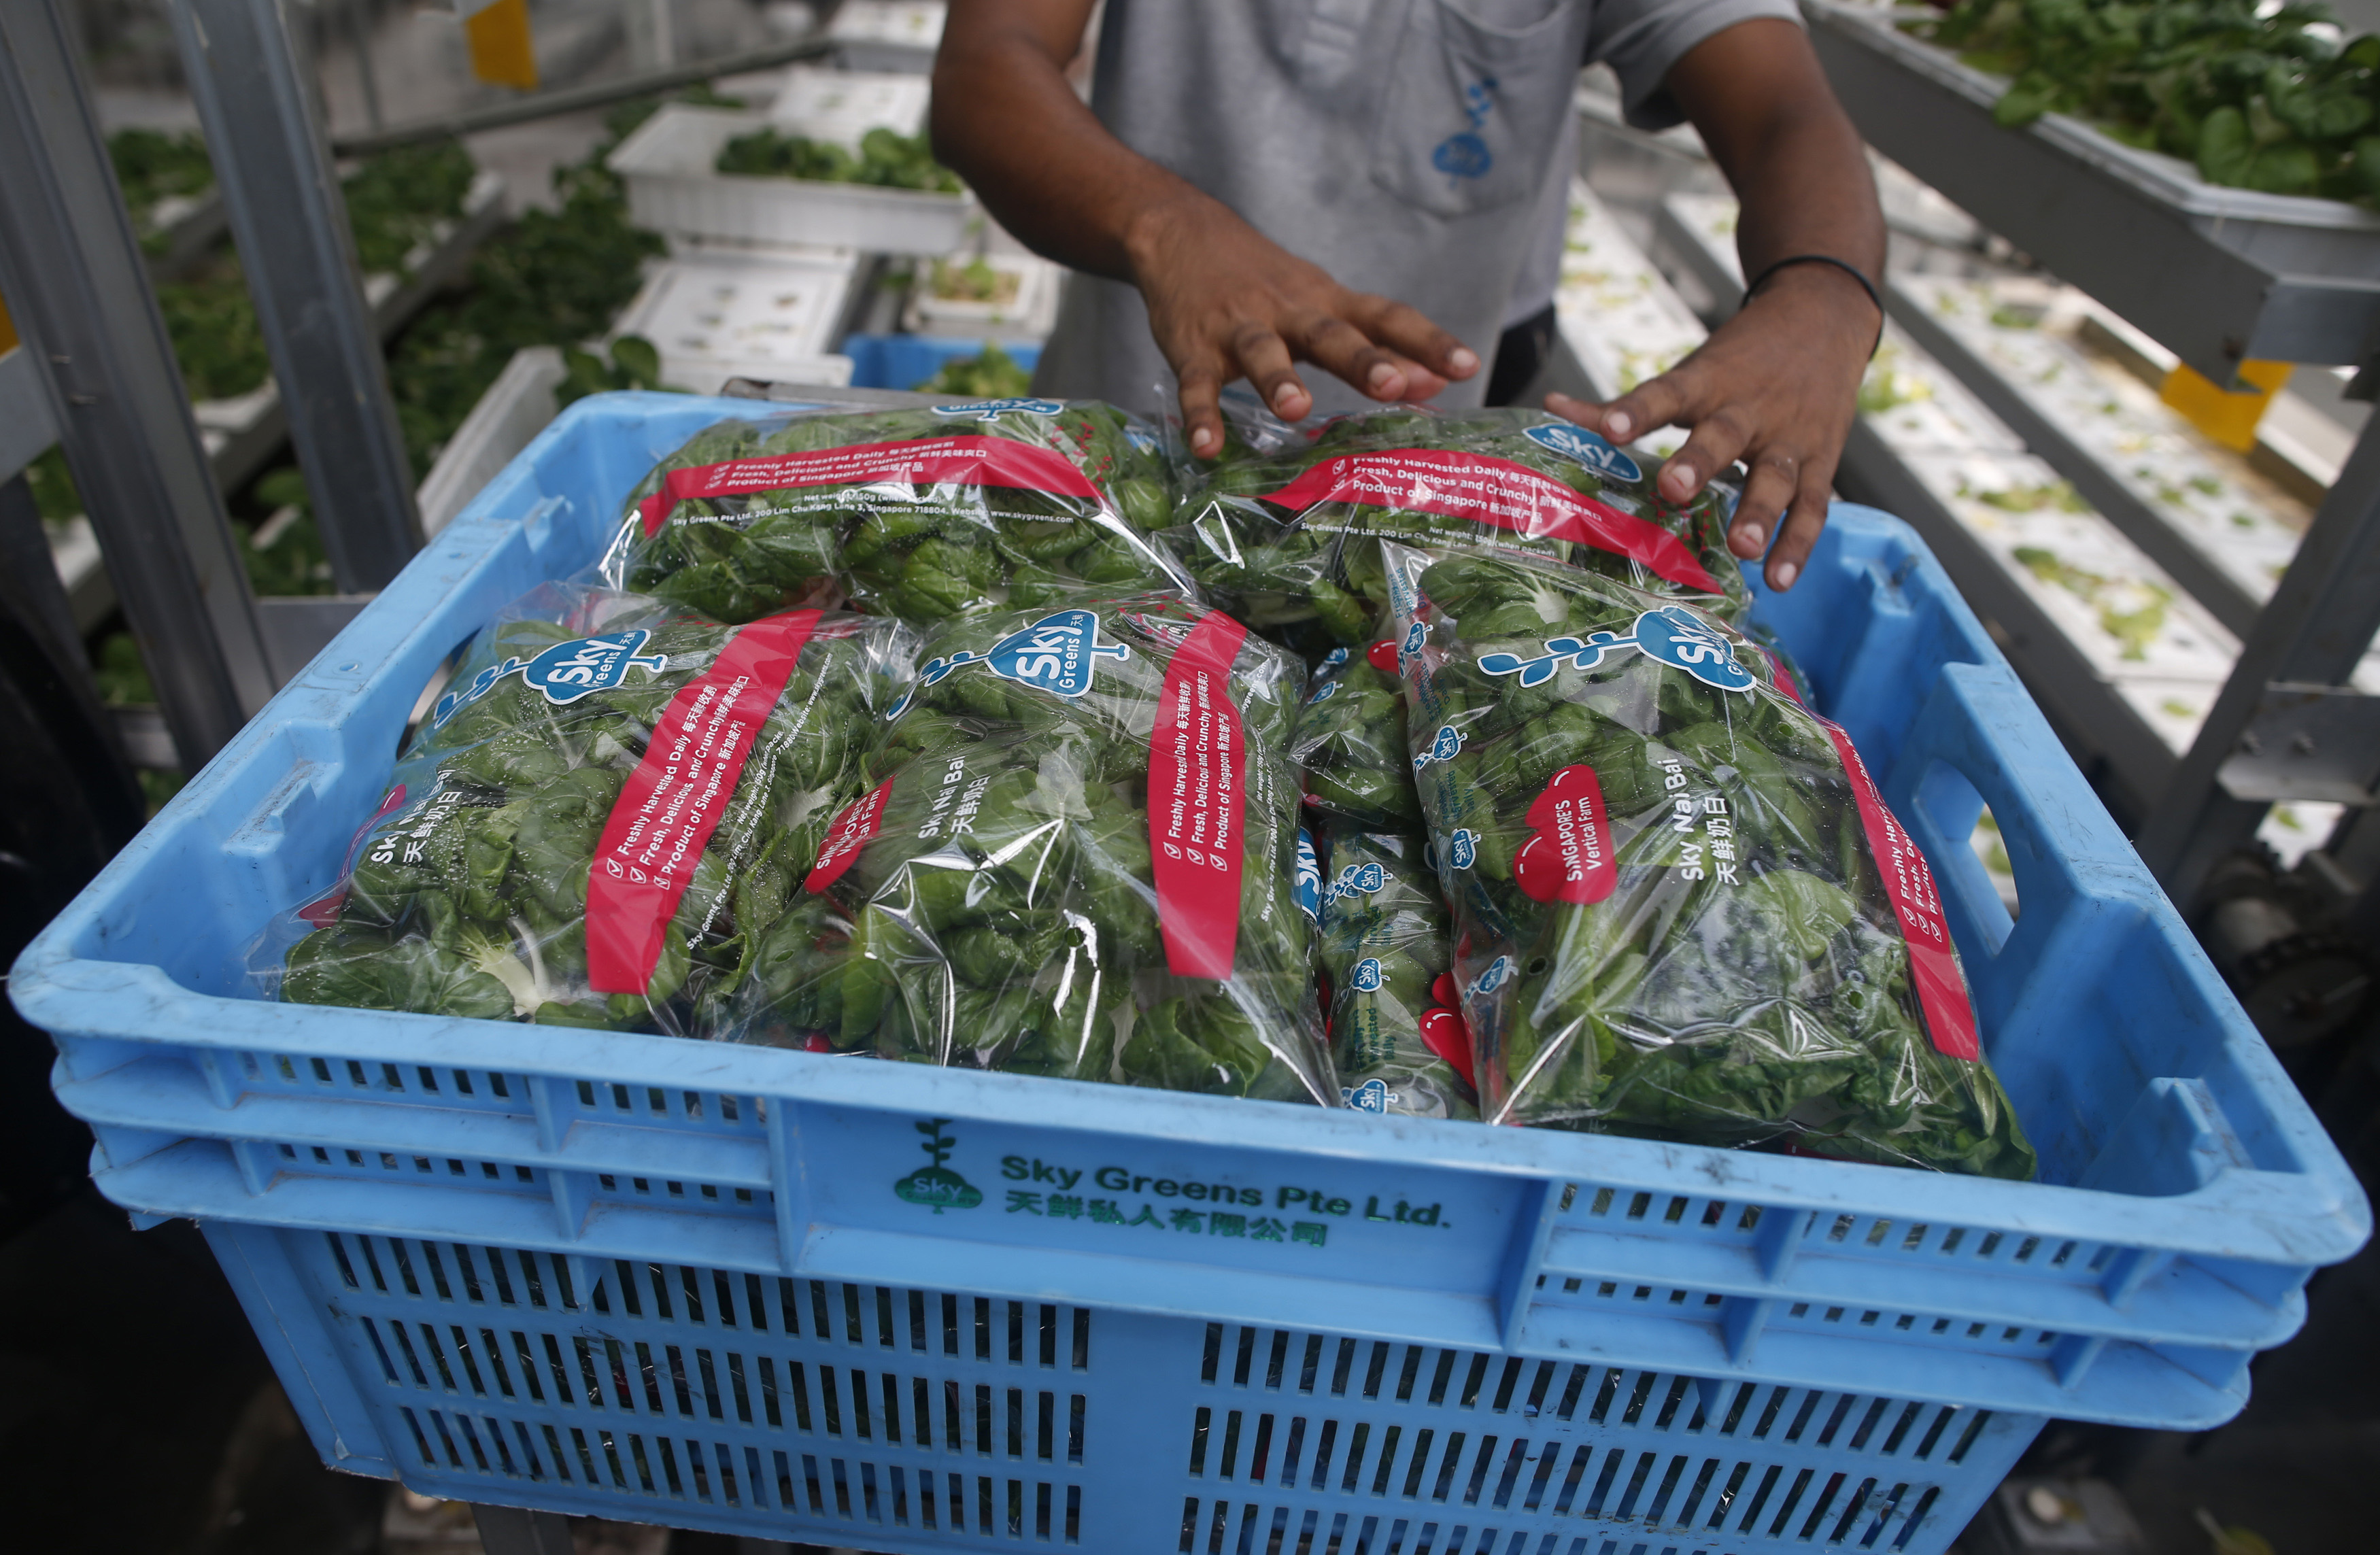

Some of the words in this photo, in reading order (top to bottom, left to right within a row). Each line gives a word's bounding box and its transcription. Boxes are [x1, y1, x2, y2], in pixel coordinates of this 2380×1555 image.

[731, 471, 770, 479] Fresh,
[775, 464, 833, 476] Delicious
[864, 454, 915, 467] Crunchy
[735, 462, 783, 471] Freshly
[785, 454, 850, 467] Harvested
[853, 450, 885, 460] Daily
[1548, 428, 1616, 468] Sky
[727, 477, 778, 487] Product
[799, 470, 864, 482] Singapore
[1353, 457, 1400, 466] Freshly
[1405, 458, 1470, 474] Harvested
[1474, 465, 1506, 480] Daily
[1353, 466, 1393, 479] Fresh,
[1397, 469, 1457, 486] Delicious
[1460, 479, 1483, 491] and
[1486, 483, 1536, 506] Crunchy
[1353, 480, 1404, 496] Product
[1407, 488, 1421, 498] of
[1425, 490, 1488, 510] Singapore
[755, 510, 771, 518] 200
[991, 509, 1074, 524] www.skygreens.com
[1379, 529, 1396, 538] 200
[1016, 626, 1083, 679] Sky
[1669, 617, 1724, 665] Sky
[547, 640, 627, 684] Sky
[583, 651, 621, 687] Greens
[1059, 638, 1080, 688] Greens
[694, 715, 725, 759] Crunchy
[1174, 732, 1189, 755] Daily
[1196, 711, 1212, 751] Crunchy
[1440, 736, 1454, 756] Sky
[687, 757, 703, 779] and
[943, 755, 966, 785] Bai
[1196, 753, 1208, 767] and
[1219, 752, 1233, 791] Singapore
[1658, 758, 1687, 790] Bai
[617, 815, 651, 855] Freshly
[641, 766, 678, 814] Harvested
[668, 734, 692, 762] Daily
[660, 783, 694, 825] Delicious
[686, 932, 703, 950] Sky
[715, 888, 728, 904] Pte
[724, 874, 732, 888] Ltd.
[732, 844, 743, 860] Lim
[741, 829, 753, 843] Chu
[749, 809, 762, 828] Kang
[758, 791, 768, 809] Lane
[792, 705, 811, 735] Website:
[808, 653, 833, 706] www.skygreens.com
[694, 762, 727, 810] Singapore
[737, 810, 748, 825] Net
[745, 785, 760, 810] weight:
[754, 768, 766, 785] 150g
[862, 790, 881, 821] Farm
[932, 785, 958, 811] Nai
[950, 776, 991, 834] 天鲜奶白
[1218, 791, 1230, 804] of
[371, 830, 408, 864] Sky
[398, 797, 432, 825] Nai
[428, 770, 456, 797] Bai
[403, 791, 463, 863] 天鲜奶白
[690, 809, 703, 824] of
[918, 811, 949, 838] Sky
[1168, 798, 1187, 838] Freshly
[1191, 811, 1208, 844] Fresh,
[1214, 806, 1229, 849] Product
[1578, 796, 1593, 821] Farm
[1669, 793, 1695, 832] Nai
[639, 827, 672, 866] Fresh,
[661, 824, 696, 874] Product
[1454, 838, 1467, 864] Sky
[1555, 799, 1584, 881] SINGAPORE'S
[1579, 823, 1602, 870] Vertical
[1703, 797, 1739, 886] 天鲜奶白
[1361, 870, 1378, 887] Sky
[1679, 841, 1704, 881] Sky
[1892, 847, 1910, 900] Freshly
[1911, 864, 1924, 907] Fresh,
[1920, 857, 1938, 915] Product
[1261, 903, 1273, 922] Sky
[1358, 966, 1375, 985] Sky
[1360, 1088, 1380, 1108] Sky
[913, 1177, 963, 1202] Sky
[1001, 1155, 1083, 1190] Sky
[1095, 1166, 1262, 1206] Greens
[1276, 1186, 1352, 1216] Pte
[1366, 1195, 1450, 1229] Ltd.
